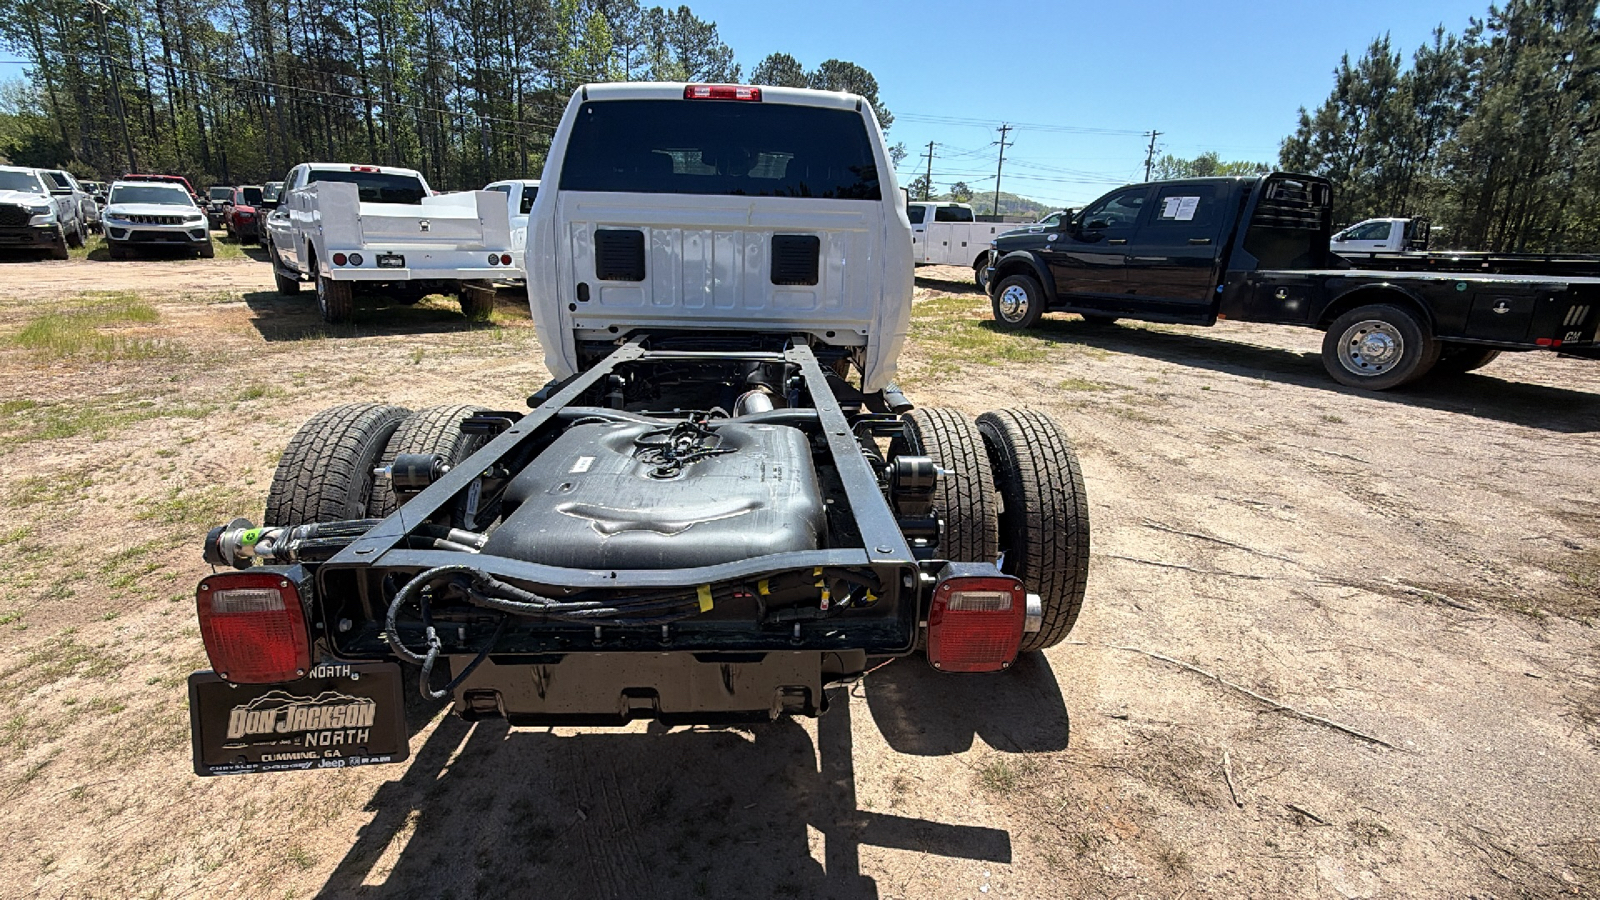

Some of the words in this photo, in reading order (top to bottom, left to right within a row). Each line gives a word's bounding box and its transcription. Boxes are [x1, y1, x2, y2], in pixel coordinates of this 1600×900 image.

[310, 665, 350, 679] NORTH
[227, 709, 277, 739] DON
[277, 703, 376, 733] JACKSON
[305, 728, 370, 747] NORTH
[324, 749, 342, 758] GA
[317, 758, 346, 768] Jeep
[361, 756, 391, 764] RAM
